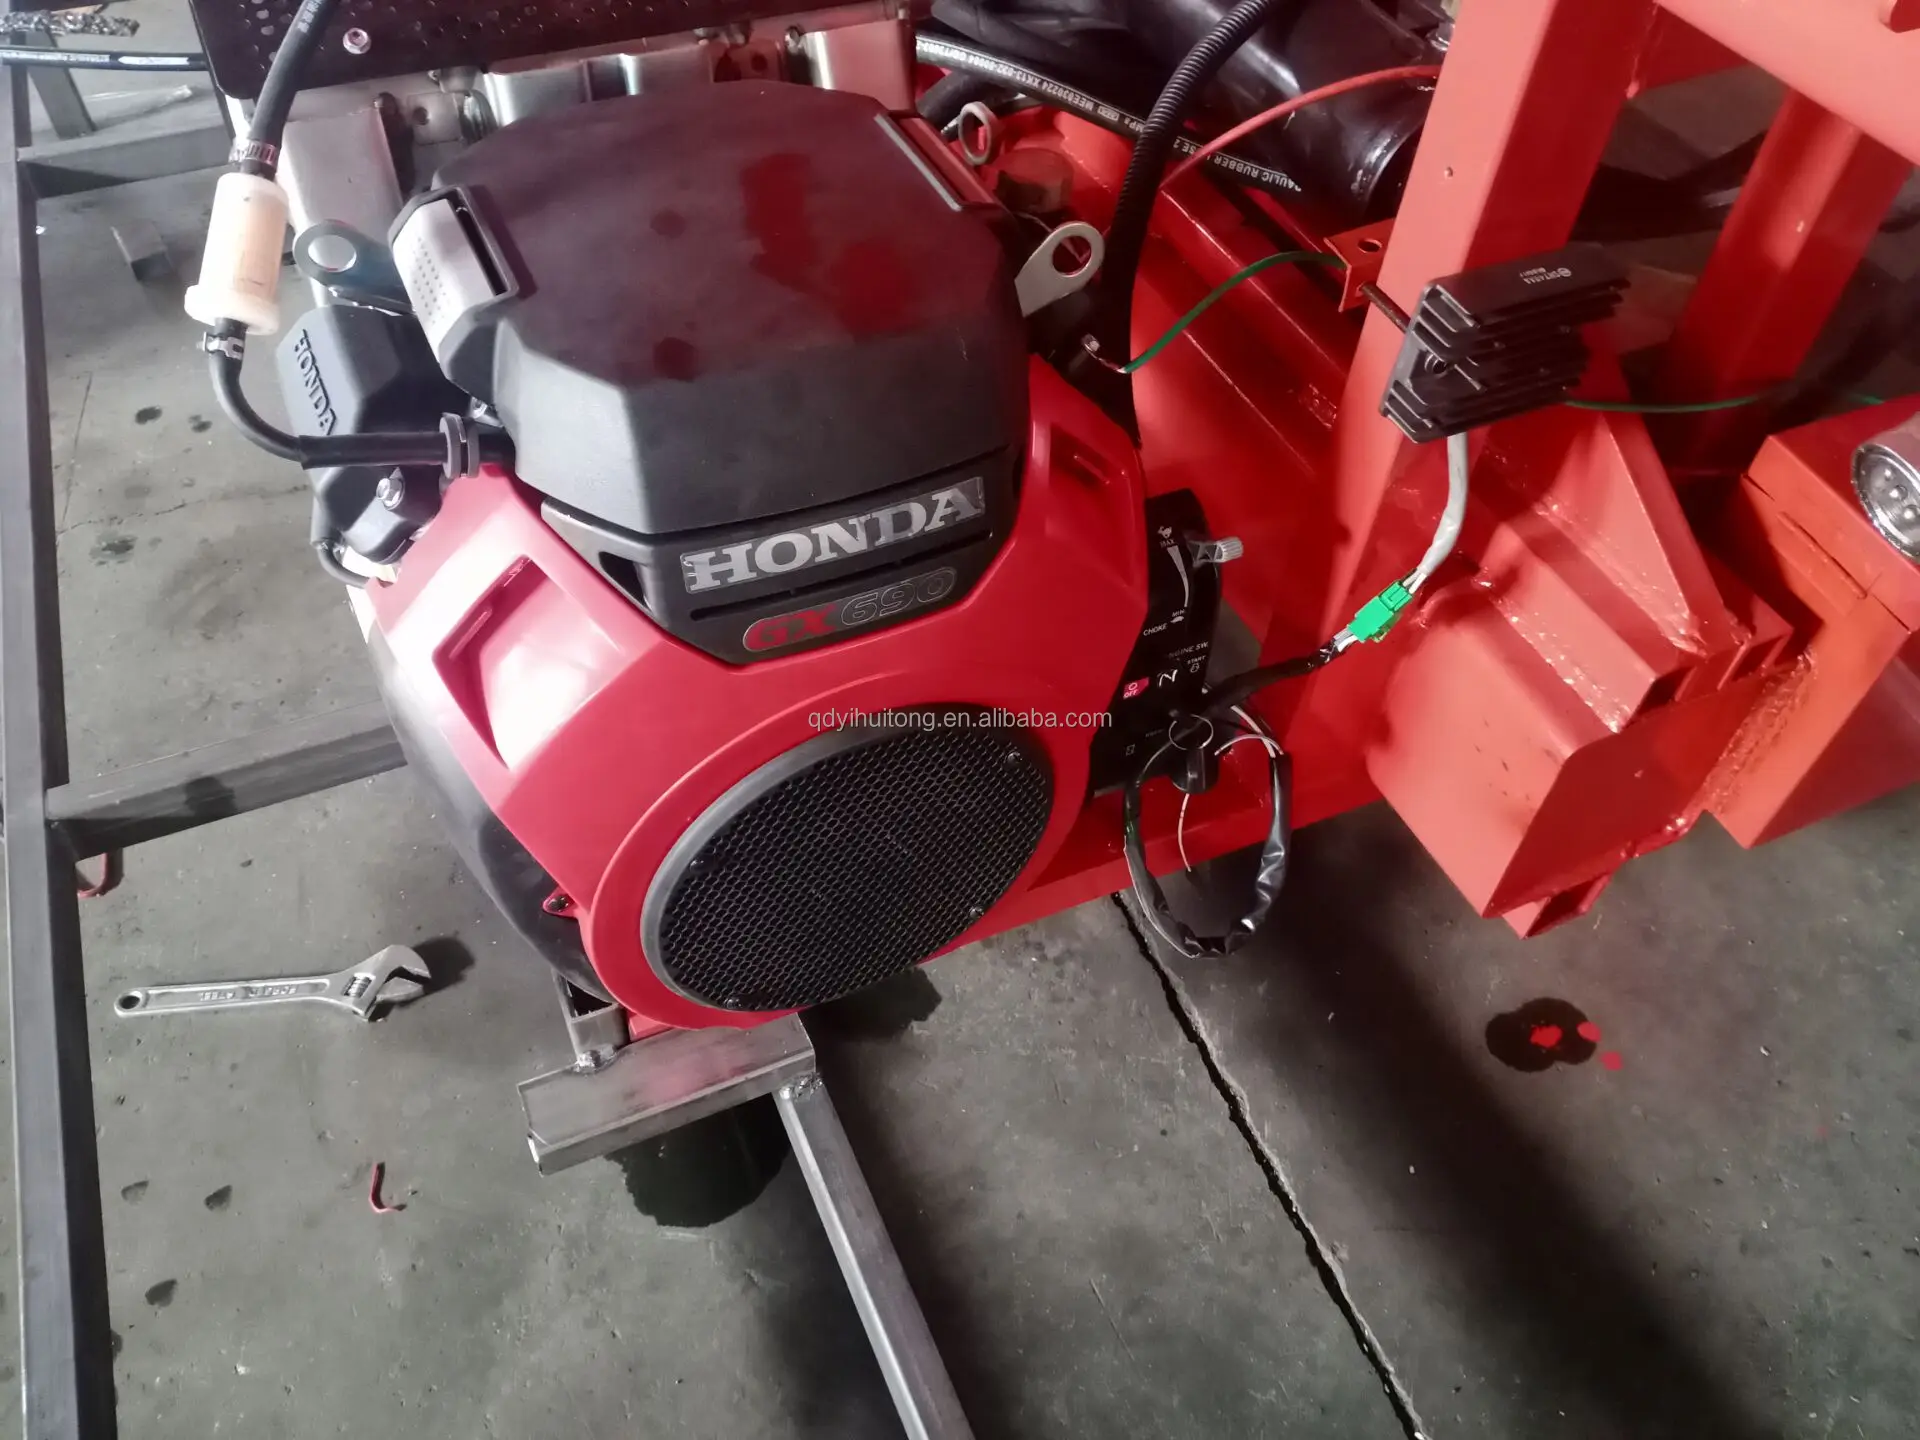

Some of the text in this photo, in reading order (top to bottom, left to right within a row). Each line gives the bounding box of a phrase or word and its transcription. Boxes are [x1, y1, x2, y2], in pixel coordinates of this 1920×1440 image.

[1214, 155, 1259, 178] RUBBER
[1260, 172, 1301, 192] AULIC
[293, 328, 337, 436] HONDA
[688, 486, 984, 592] HONDA
[1160, 539, 1176, 549] MAX
[1172, 609, 1186, 618] MIN
[1142, 622, 1168, 637] CHOKE
[1166, 645, 1194, 659] NGINE
[1187, 655, 1207, 665] START
[1123, 689, 1139, 699] OFF
